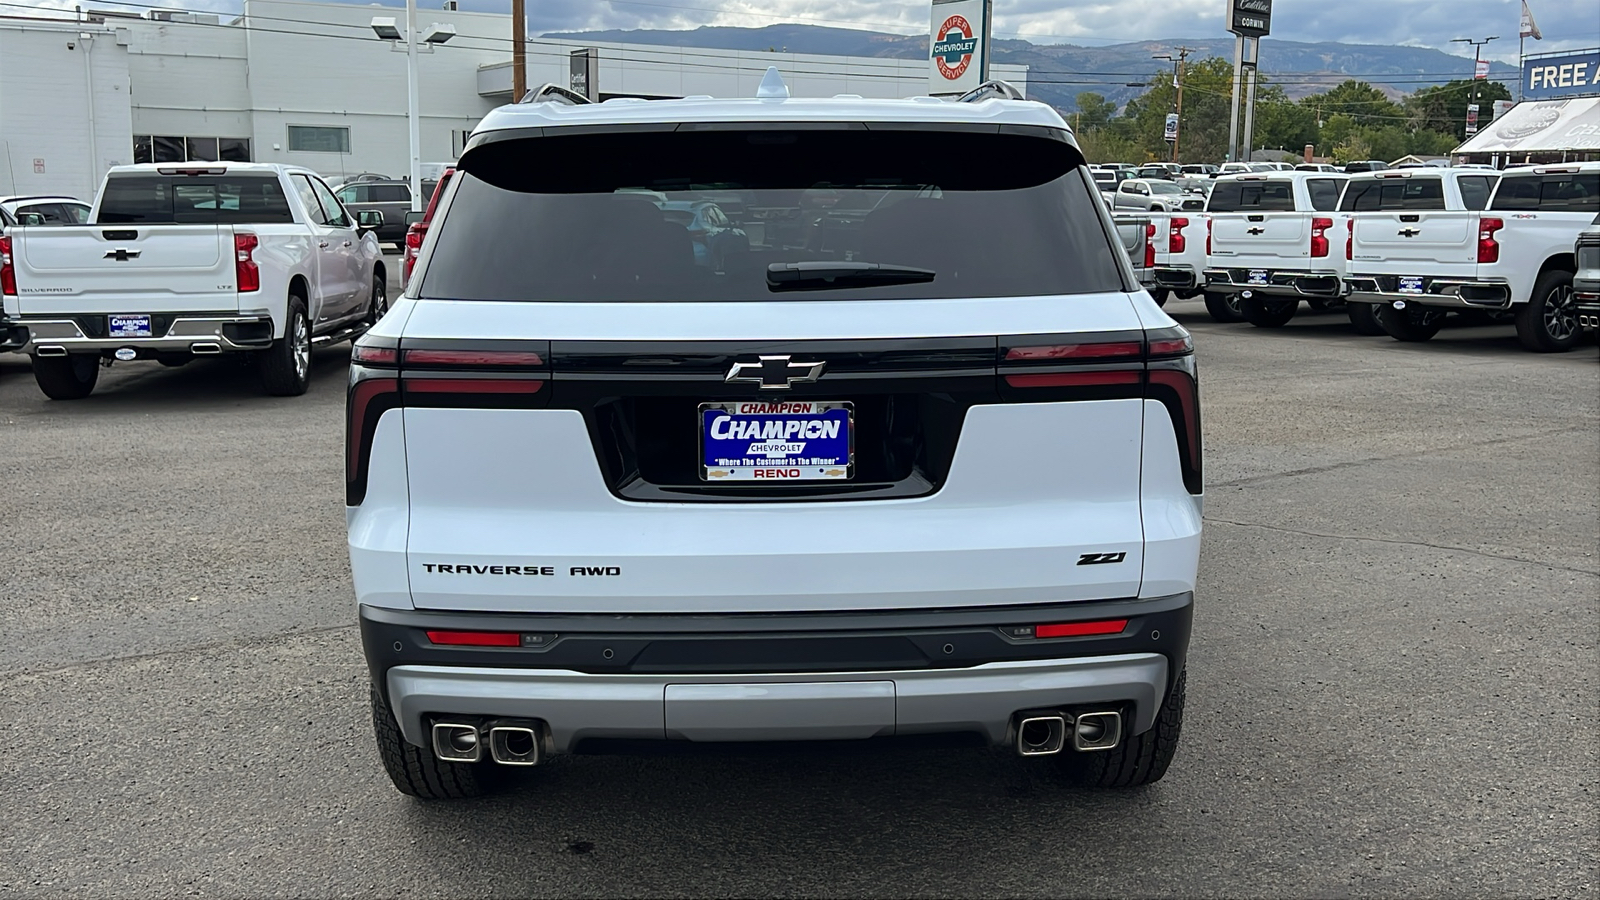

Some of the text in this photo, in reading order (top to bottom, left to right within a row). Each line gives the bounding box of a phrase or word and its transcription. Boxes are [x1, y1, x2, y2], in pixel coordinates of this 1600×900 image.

[1240, 0, 1269, 12] Cadillac
[941, 17, 968, 34] SUPER
[1241, 17, 1264, 29] CORWIN
[934, 42, 974, 53] CHEVROLET
[938, 57, 968, 79] SERVICE
[1530, 62, 1588, 90] FREE
[111, 318, 149, 326] CHAMPION
[740, 403, 813, 414] CHAMPION
[710, 415, 841, 440] CHAMPION
[750, 444, 801, 452] CHEVROLET
[742, 458, 755, 466] The
[756, 458, 788, 466] Customer
[789, 458, 796, 466] Is
[797, 458, 810, 466] The
[753, 469, 801, 478] RENO
[422, 563, 621, 576] TRAVERSE AWD
